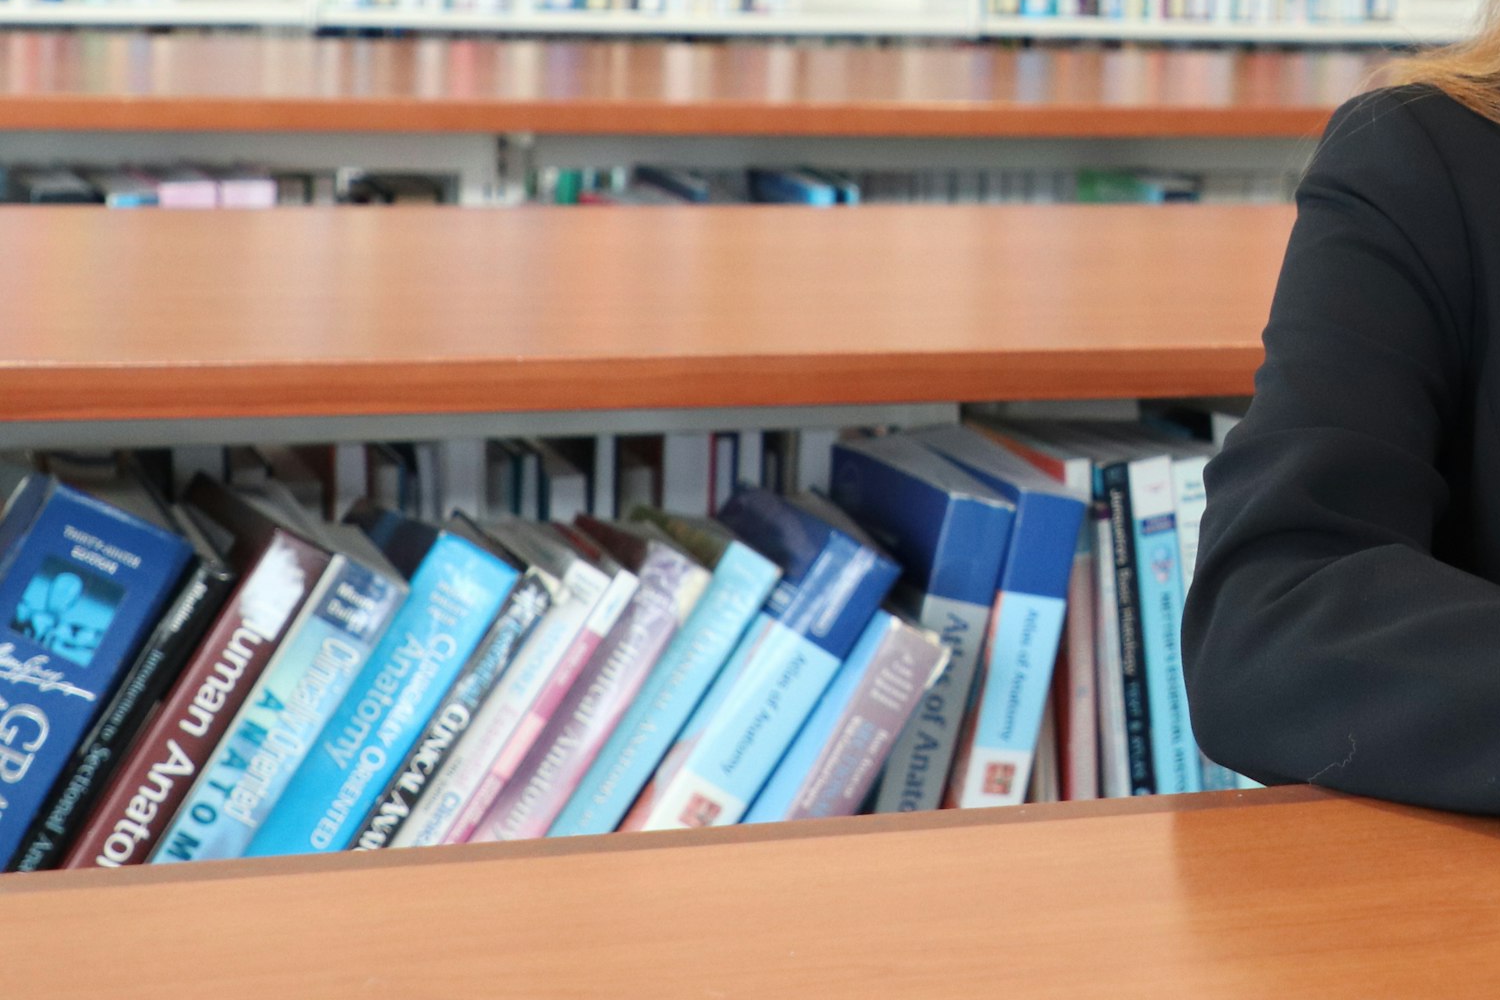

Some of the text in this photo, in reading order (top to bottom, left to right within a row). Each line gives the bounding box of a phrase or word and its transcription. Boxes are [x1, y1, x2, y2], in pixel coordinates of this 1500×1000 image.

[778, 653, 807, 695] Atlas
[1021, 608, 1039, 648] Atlas
[178, 617, 266, 737] uman
[324, 632, 425, 769] Anatomy
[376, 633, 457, 746] CLINICALLY
[922, 695, 946, 727] of
[1000, 672, 1026, 742] Anatomy
[223, 637, 361, 828] Clinically Oriented
[396, 703, 470, 794] CLINICAL
[492, 624, 649, 840] Clinical Anatomy
[721, 709, 771, 777] Anatomy
[46, 742, 111, 835] Sectional
[309, 745, 387, 850] ORIENTED
